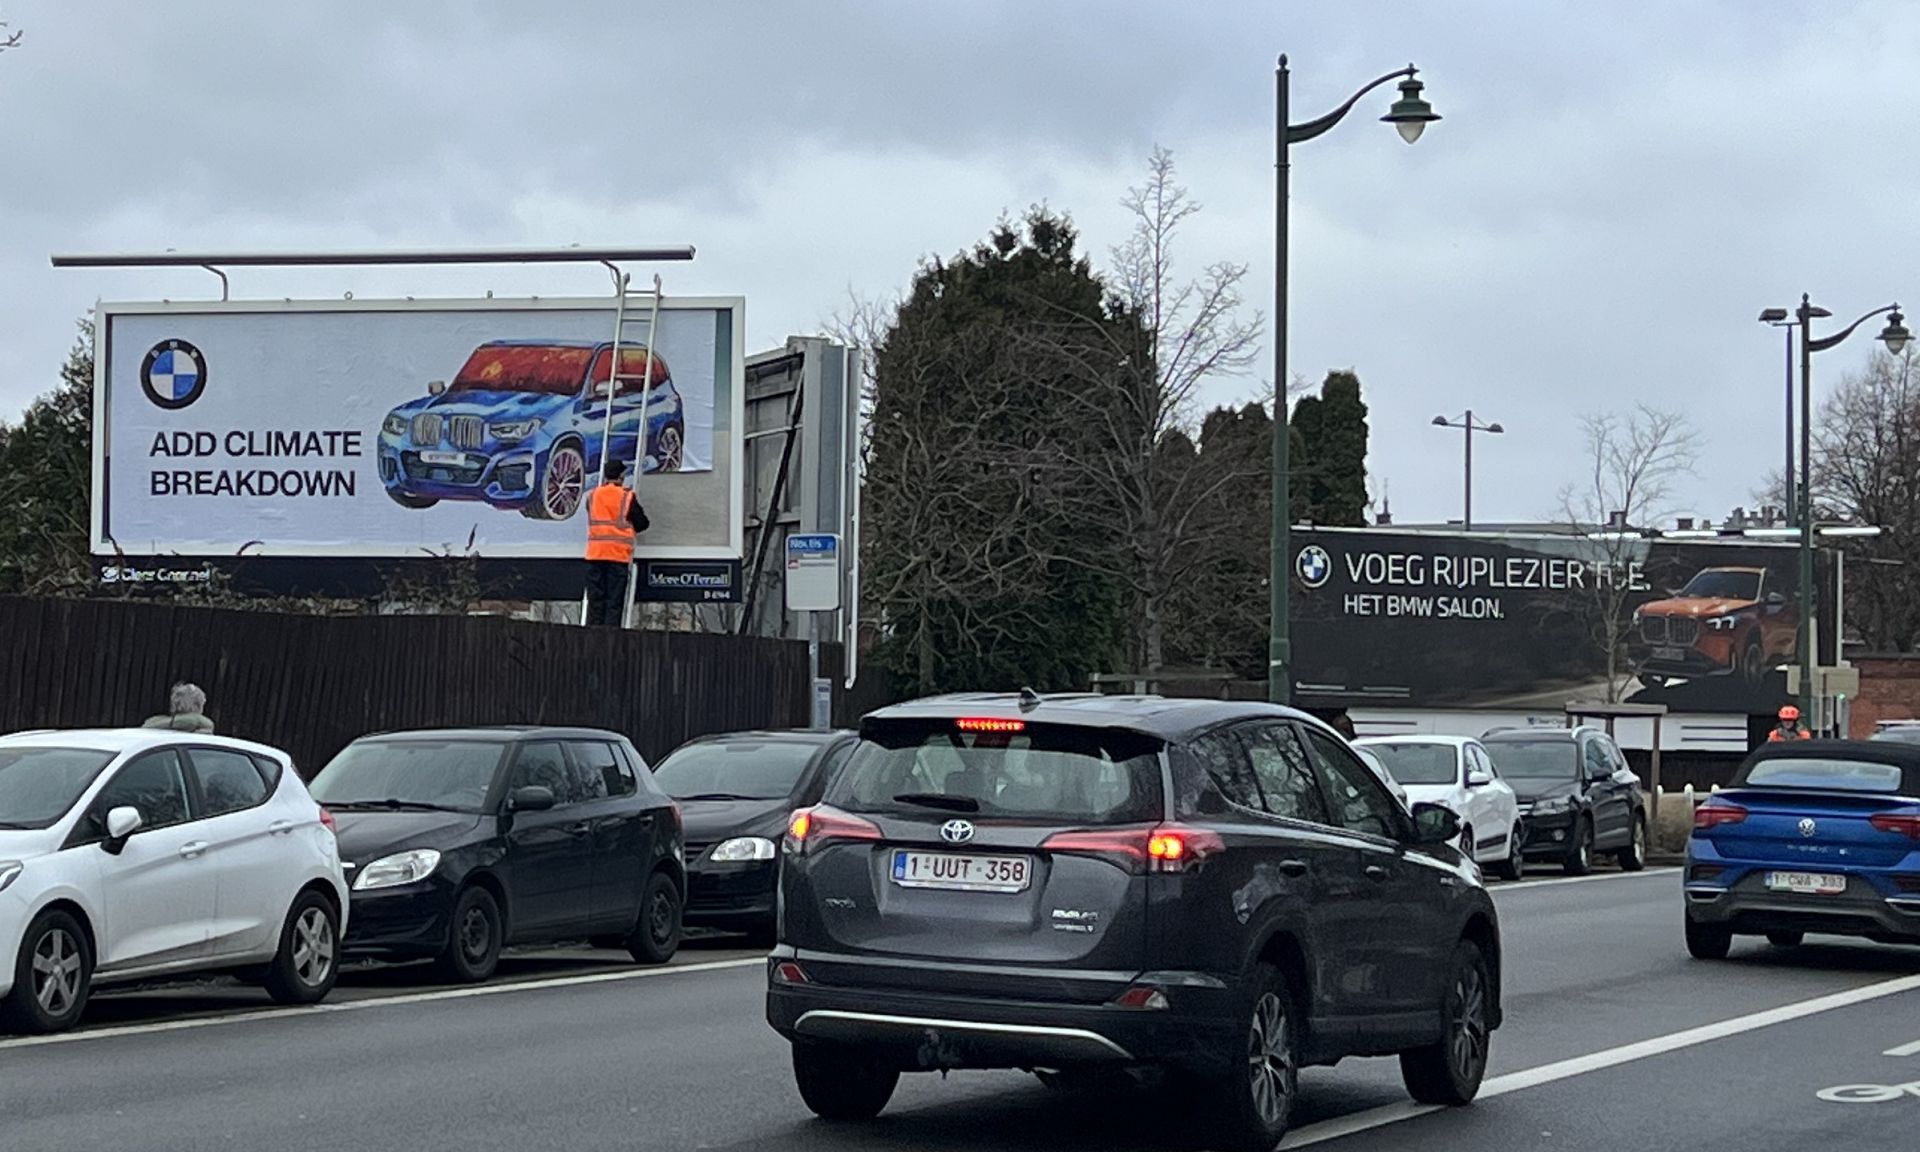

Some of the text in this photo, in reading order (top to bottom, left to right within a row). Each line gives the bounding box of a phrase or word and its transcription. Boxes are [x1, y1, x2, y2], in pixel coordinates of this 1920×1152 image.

[149, 430, 362, 457] ADD CLIMATE
[151, 469, 356, 497] BREAKDOWN
[1345, 552, 1425, 585] VOEG
[1433, 555, 1585, 589] RIJPLEZIER
[1344, 594, 1505, 619] HET BMW SALON.
